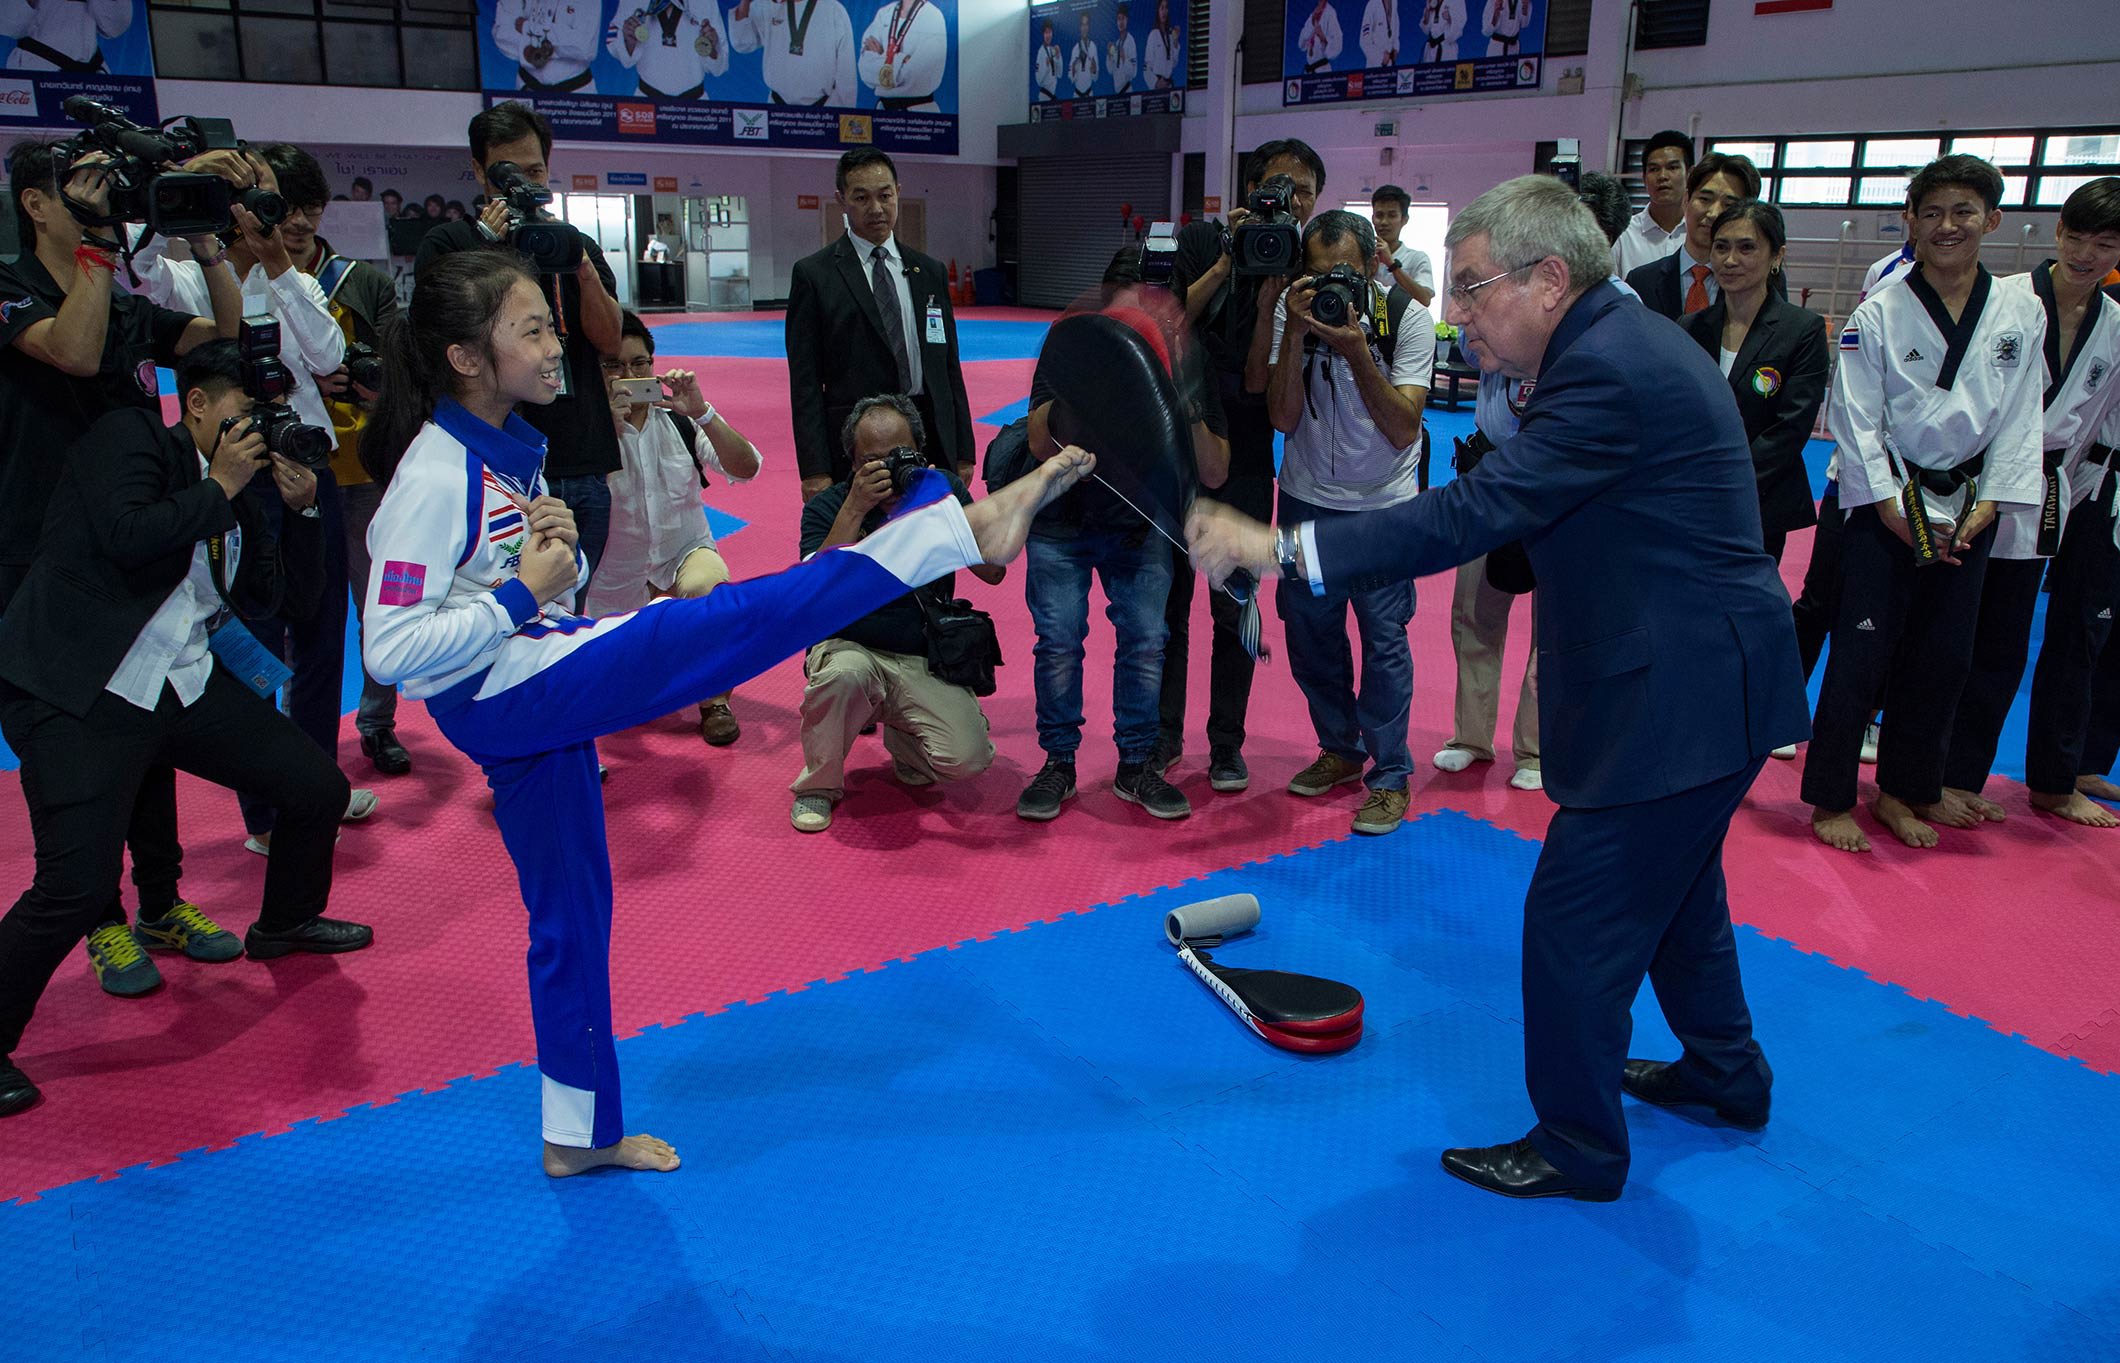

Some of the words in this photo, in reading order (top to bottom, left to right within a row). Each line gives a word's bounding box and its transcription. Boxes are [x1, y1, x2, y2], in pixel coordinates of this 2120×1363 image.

[739, 126, 763, 136] FBT
[458, 170, 475, 181] FB
[500, 553, 521, 570] FB
